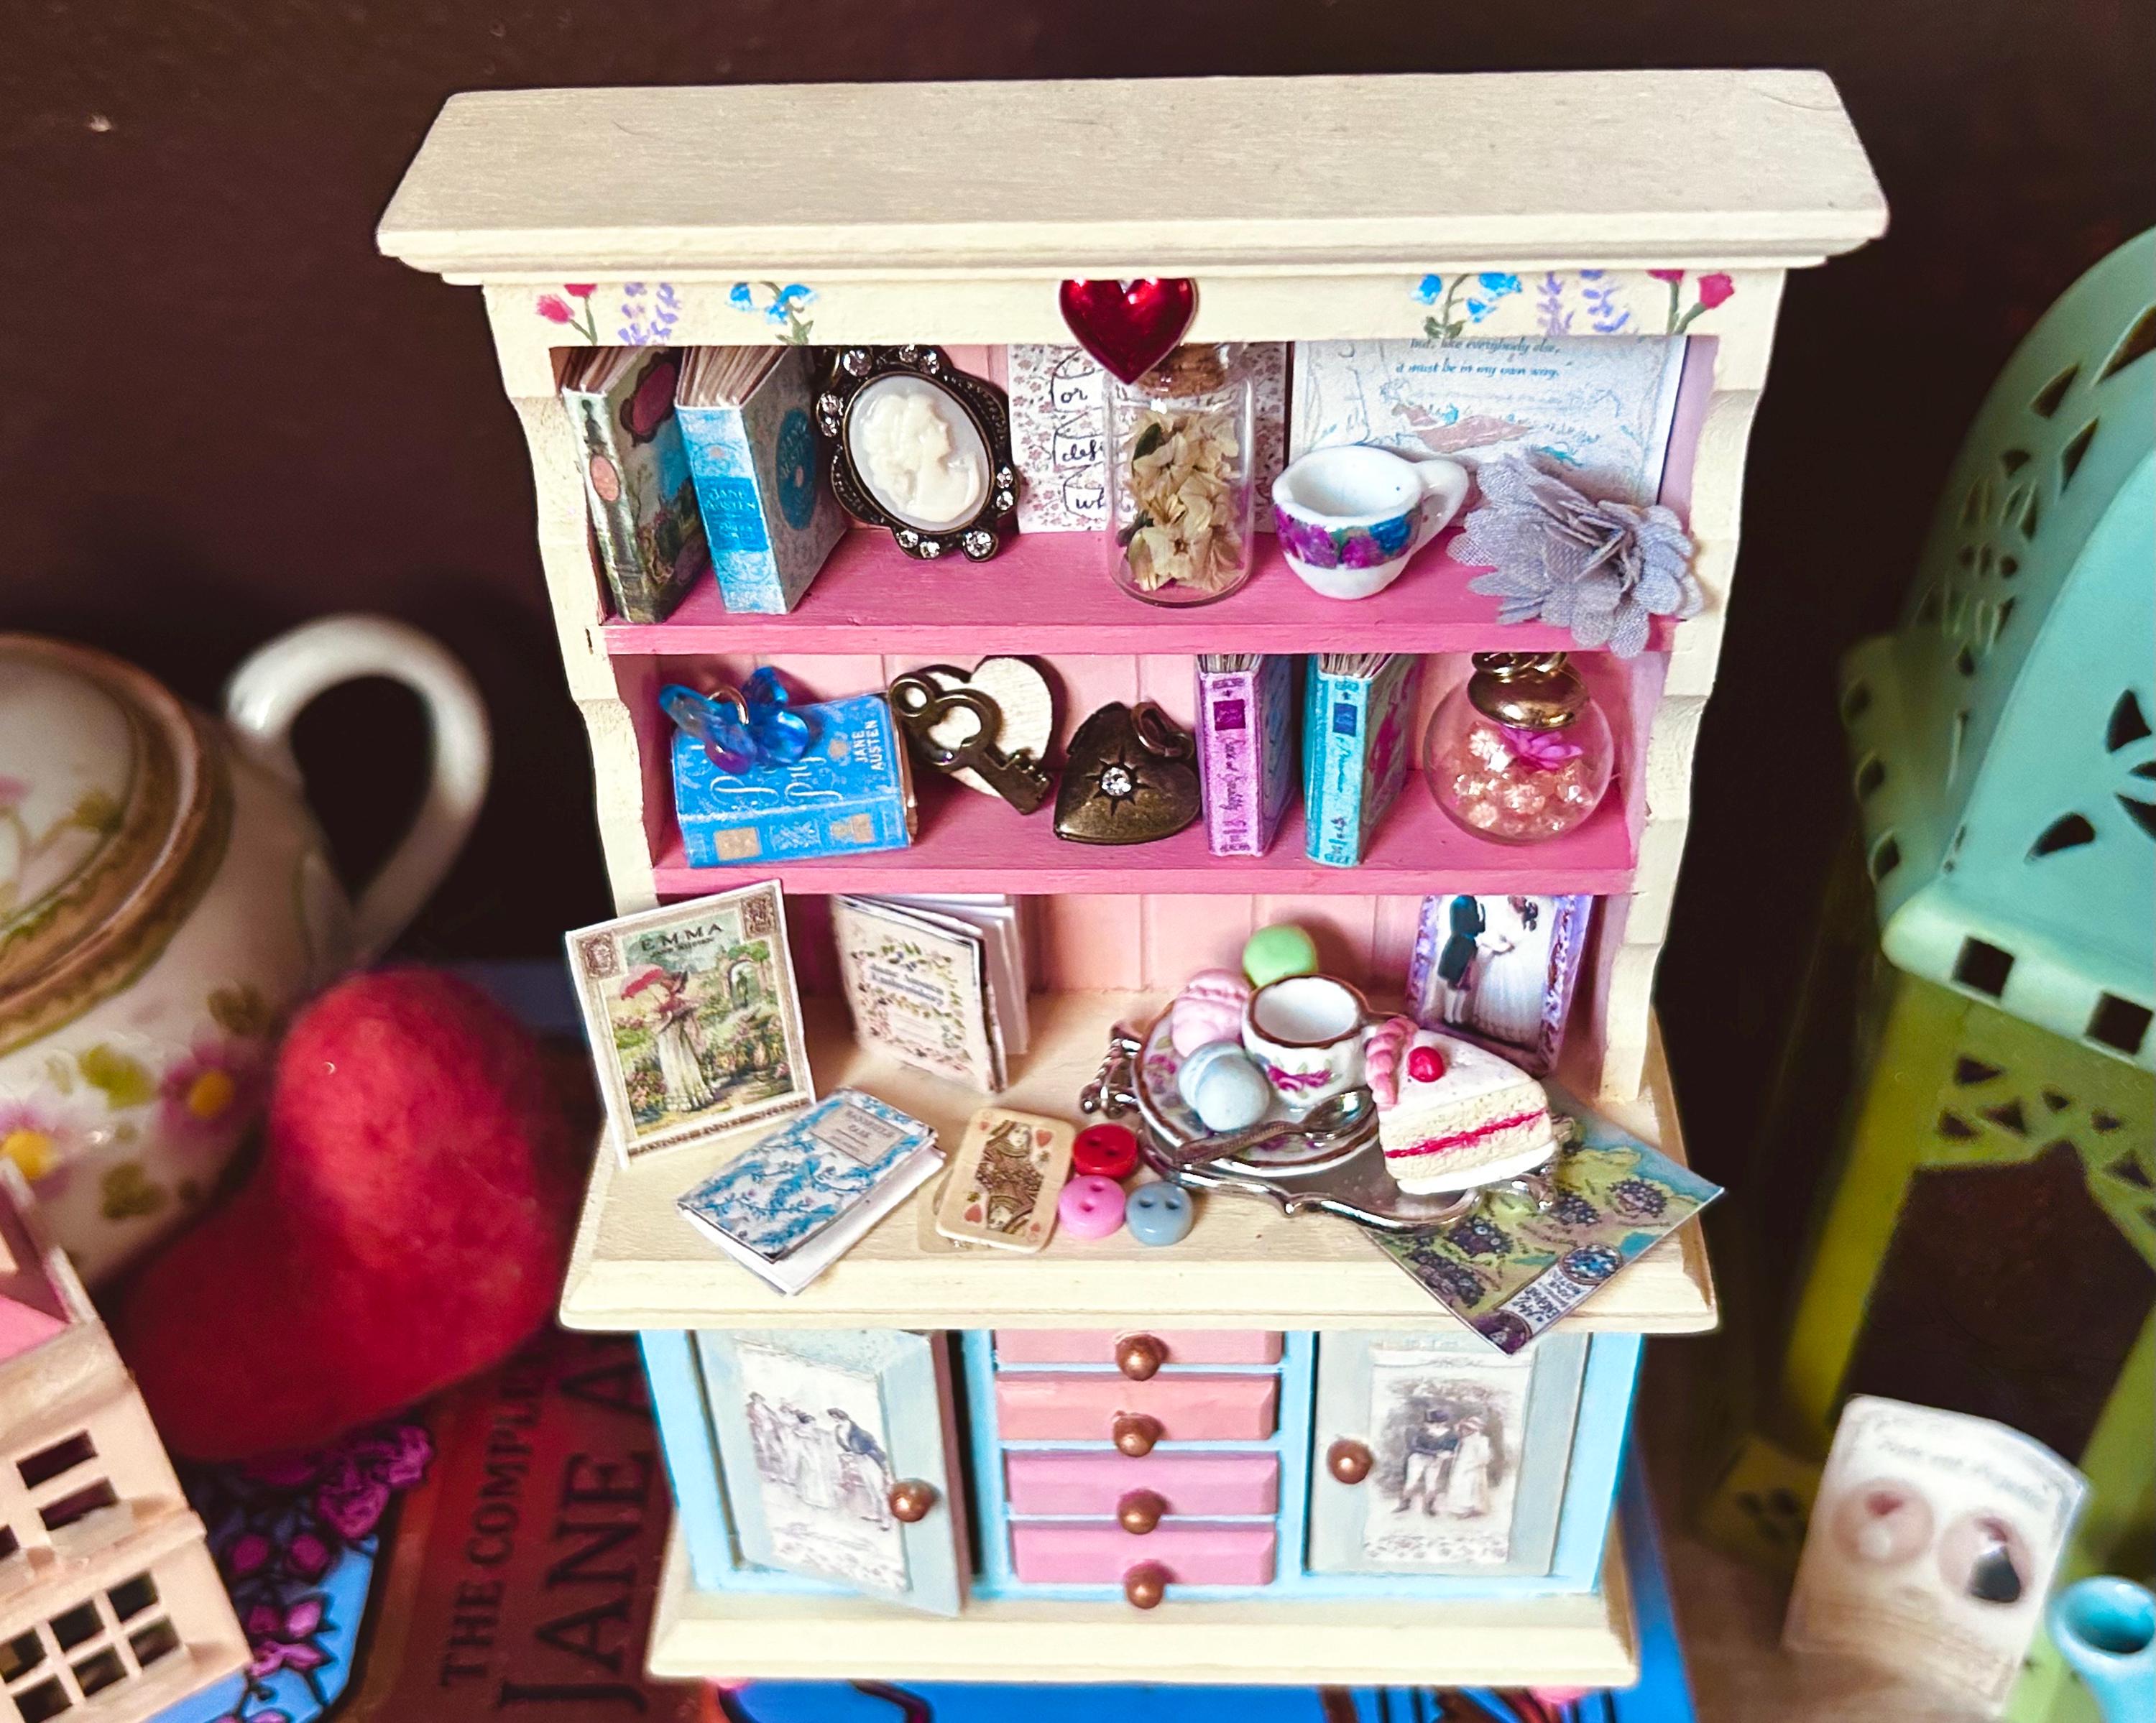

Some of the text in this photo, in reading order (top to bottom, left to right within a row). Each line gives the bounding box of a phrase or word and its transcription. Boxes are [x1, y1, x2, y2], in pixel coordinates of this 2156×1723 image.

[1409, 361, 1439, 373] must
[1442, 357, 1457, 372] be
[1476, 366, 1496, 378] my
[1060, 388, 1088, 404] or
[851, 730, 869, 763] JANE
[865, 719, 886, 772] AUSTEN
[640, 923, 724, 951] EMMA
[496, 1450, 654, 1713] JANE
[438, 1579, 505, 1689] THE
